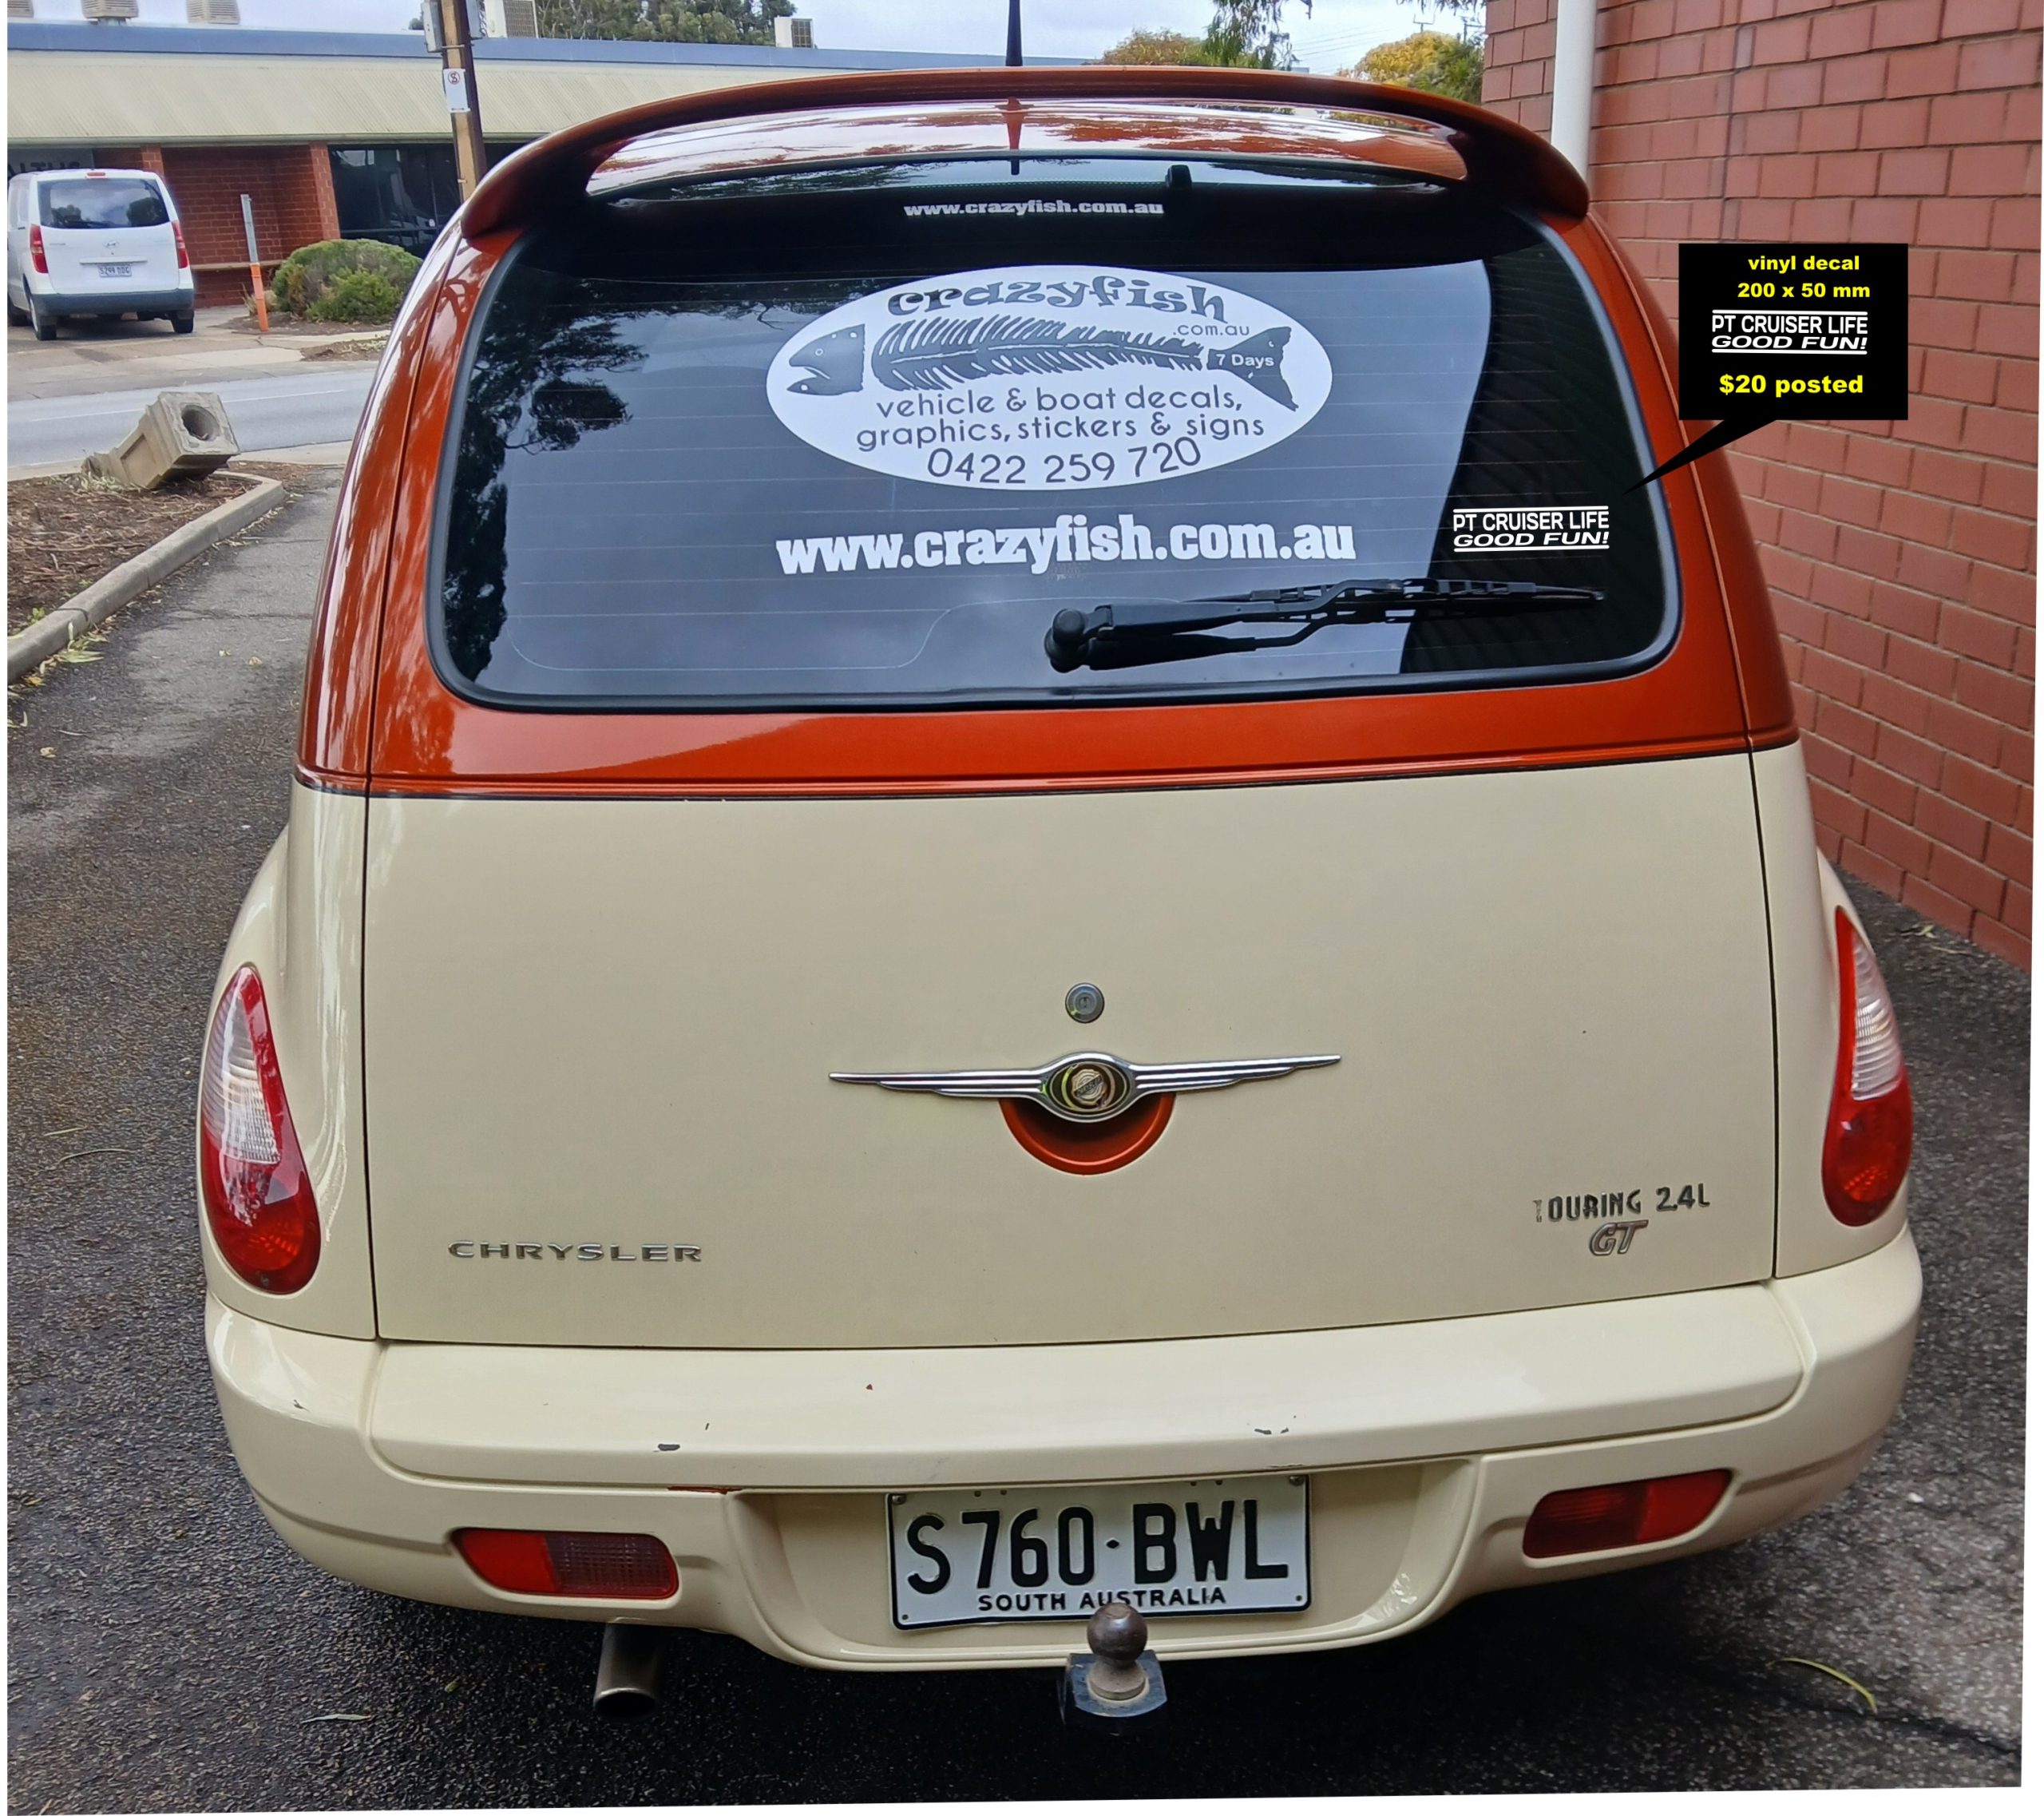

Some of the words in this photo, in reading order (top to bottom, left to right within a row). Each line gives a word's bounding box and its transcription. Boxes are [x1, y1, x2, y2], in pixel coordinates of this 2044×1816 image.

[904, 200, 1164, 216] www.crazyfish.com.au
[887, 276, 1228, 323] crazyfish
[1172, 323, 1250, 338] .com.au
[1216, 354, 1226, 366] 7
[1231, 354, 1274, 369] Days
[877, 390, 995, 418] vehicle
[1006, 388, 1026, 412] &
[1037, 387, 1116, 410] boat
[1125, 385, 1242, 410] decals,
[856, 418, 1011, 451] graphics,
[1018, 416, 1136, 439] stickers
[1151, 411, 1171, 436] &
[1186, 413, 1264, 440] signs
[927, 447, 1026, 484] 0422
[1044, 452, 1115, 482] 259
[1127, 437, 1201, 478] 720
[1453, 512, 1477, 532] PT
[1482, 512, 1563, 531] CRUISER
[1569, 512, 1610, 529] LIFE
[775, 514, 1357, 573] www.crazyfish.com.au
[1453, 533, 1535, 547] GOOD
[1543, 532, 1610, 545] FUN!
[1589, 1219, 1649, 1256] GT
[448, 1240, 701, 1262] CHRYSLER
[978, 1593, 1067, 1612] SOUTH
[1079, 1587, 1226, 1609] AUSTRALIA
